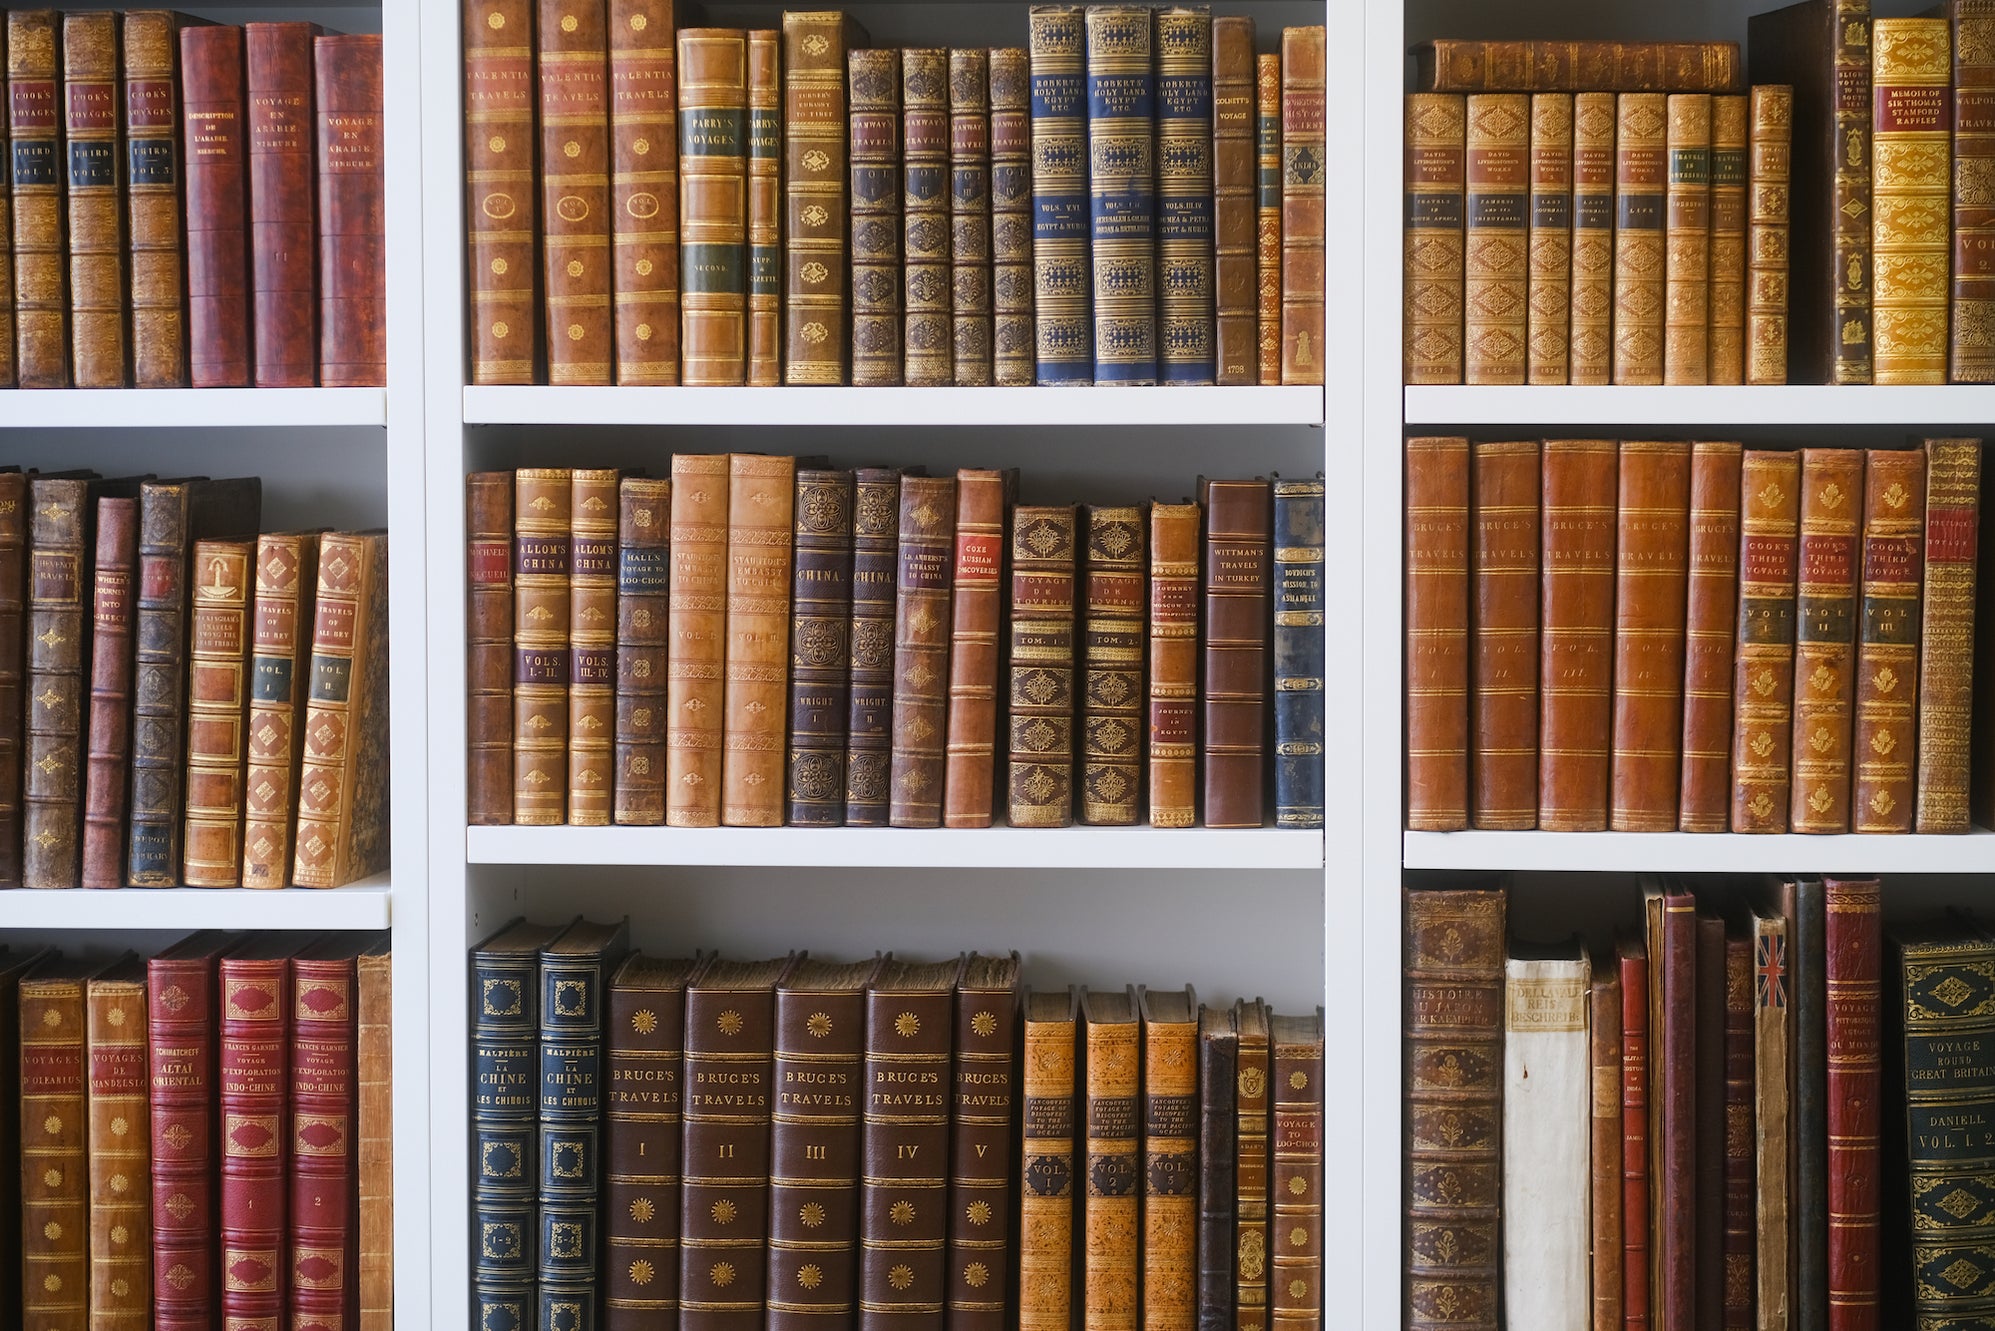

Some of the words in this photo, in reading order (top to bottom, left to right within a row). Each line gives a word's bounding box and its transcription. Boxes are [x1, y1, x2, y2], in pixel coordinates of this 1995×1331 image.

[1891, 90, 1927, 99] MEMOIR
[1929, 89, 1941, 98] OF
[1105, 97, 1137, 105] EGYPT
[1887, 99, 1904, 108] SIR
[1905, 99, 1942, 108] THOMAS
[1220, 112, 1246, 120] VOYAGE
[1891, 108, 1940, 116] STAMFORD
[1896, 117, 1937, 126] RAFFLES
[520, 544, 567, 556] ALLOM'S
[575, 544, 614, 556] ALLOM'S
[966, 545, 987, 553] COXE
[1749, 542, 1790, 551] COOK'S
[1214, 549, 1264, 557] WITTMAN'S
[1750, 554, 1786, 563] THIRD
[523, 558, 564, 570] CHINA
[575, 558, 613, 570] CHINA
[1220, 562, 1258, 570] TRAVELS
[1226, 575, 1261, 583] TURKEY
[1928, 1040, 1981, 1053] VOYAGE
[113, 1066, 126, 1075] DE
[613, 1070, 675, 1081] BRUCE'S
[1911, 1070, 1947, 1080] GREAT
[480, 1073, 528, 1085] CHINE
[547, 1073, 593, 1085] CHINE
[697, 1073, 760, 1085] BRUCE'S
[786, 1072, 847, 1085] BRUCE'S
[877, 1072, 939, 1084] BRUCE'S
[476, 1094, 491, 1104] LES
[543, 1096, 558, 1106] LES
[609, 1091, 679, 1103] TRAVELS
[693, 1094, 765, 1107] TRAVELS
[781, 1092, 851, 1106] TRAVELS
[872, 1092, 943, 1106] TRAVELS
[1277, 1120, 1316, 1129] VOYAGE
[1289, 1131, 1301, 1139] TO
[897, 1145, 920, 1160] IV
[975, 1144, 988, 1158] V
